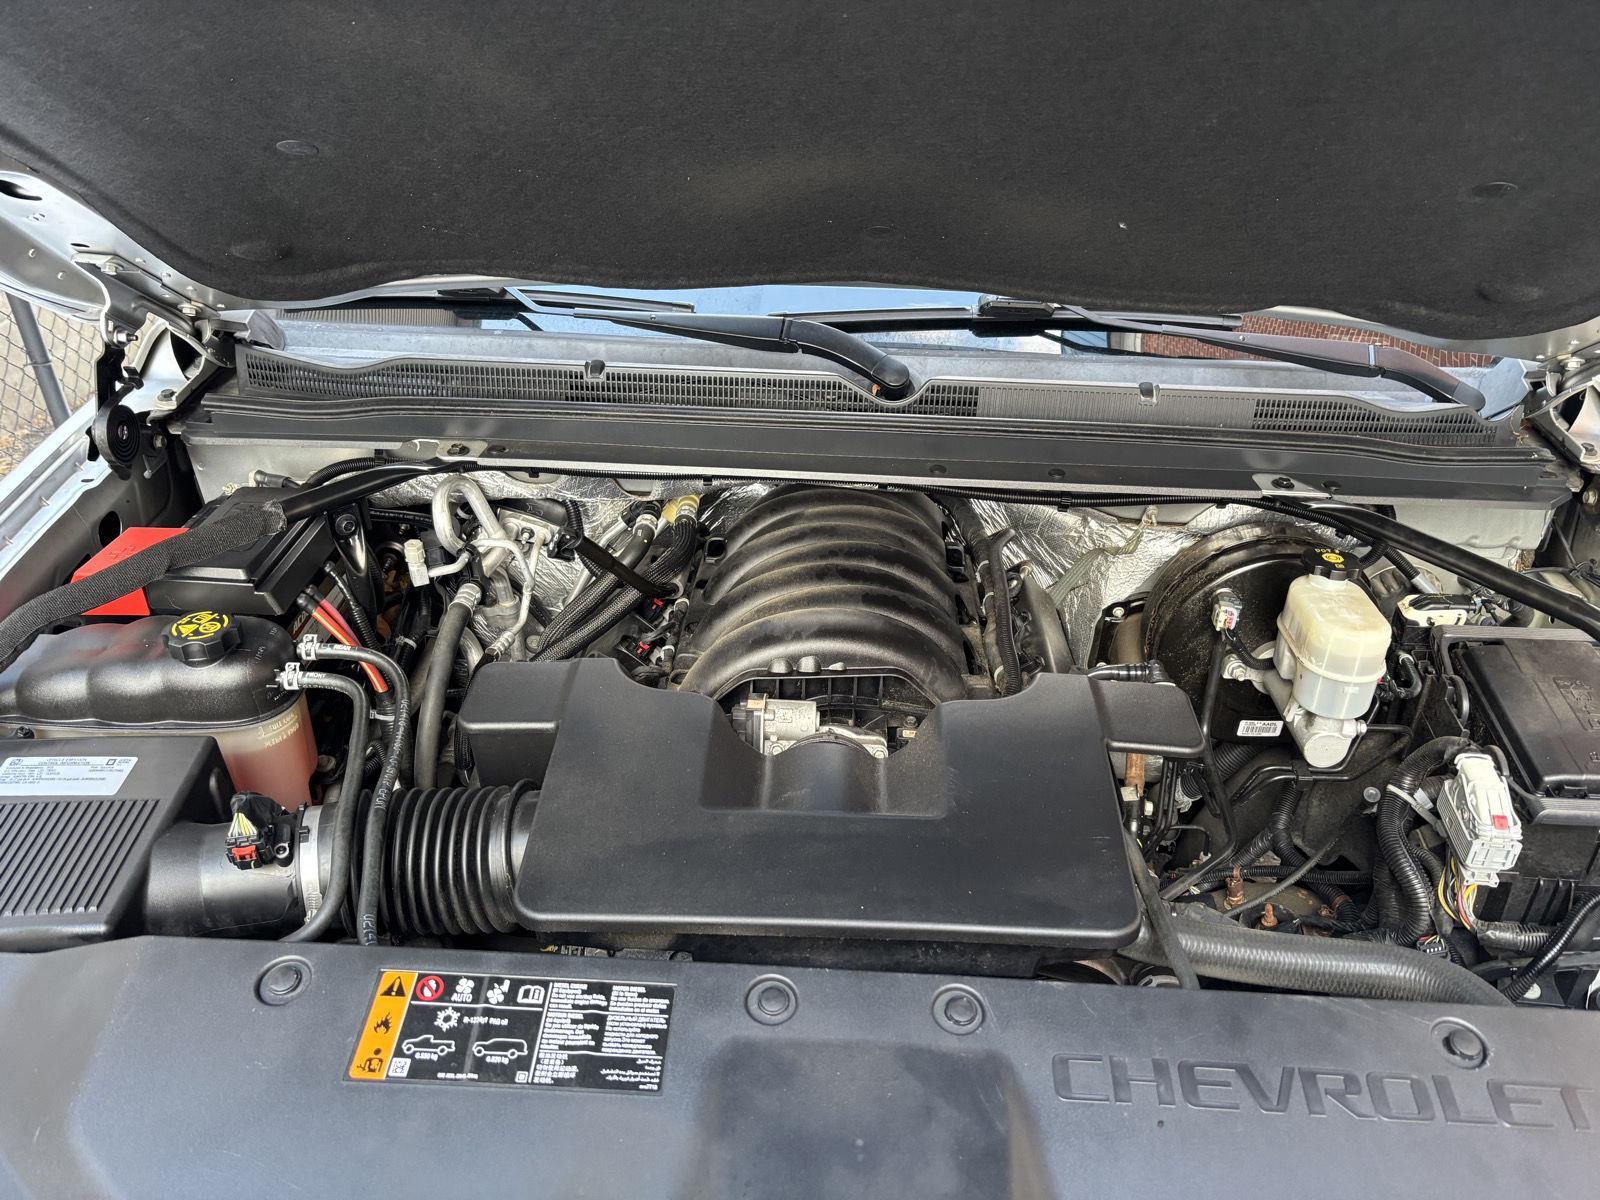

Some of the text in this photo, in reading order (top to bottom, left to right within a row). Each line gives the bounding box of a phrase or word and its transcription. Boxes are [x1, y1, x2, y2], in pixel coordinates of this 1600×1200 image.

[305, 671, 327, 679] FRONT
[451, 992, 473, 1003] AUTO
[1052, 1053, 1596, 1132] CHEVROLET
